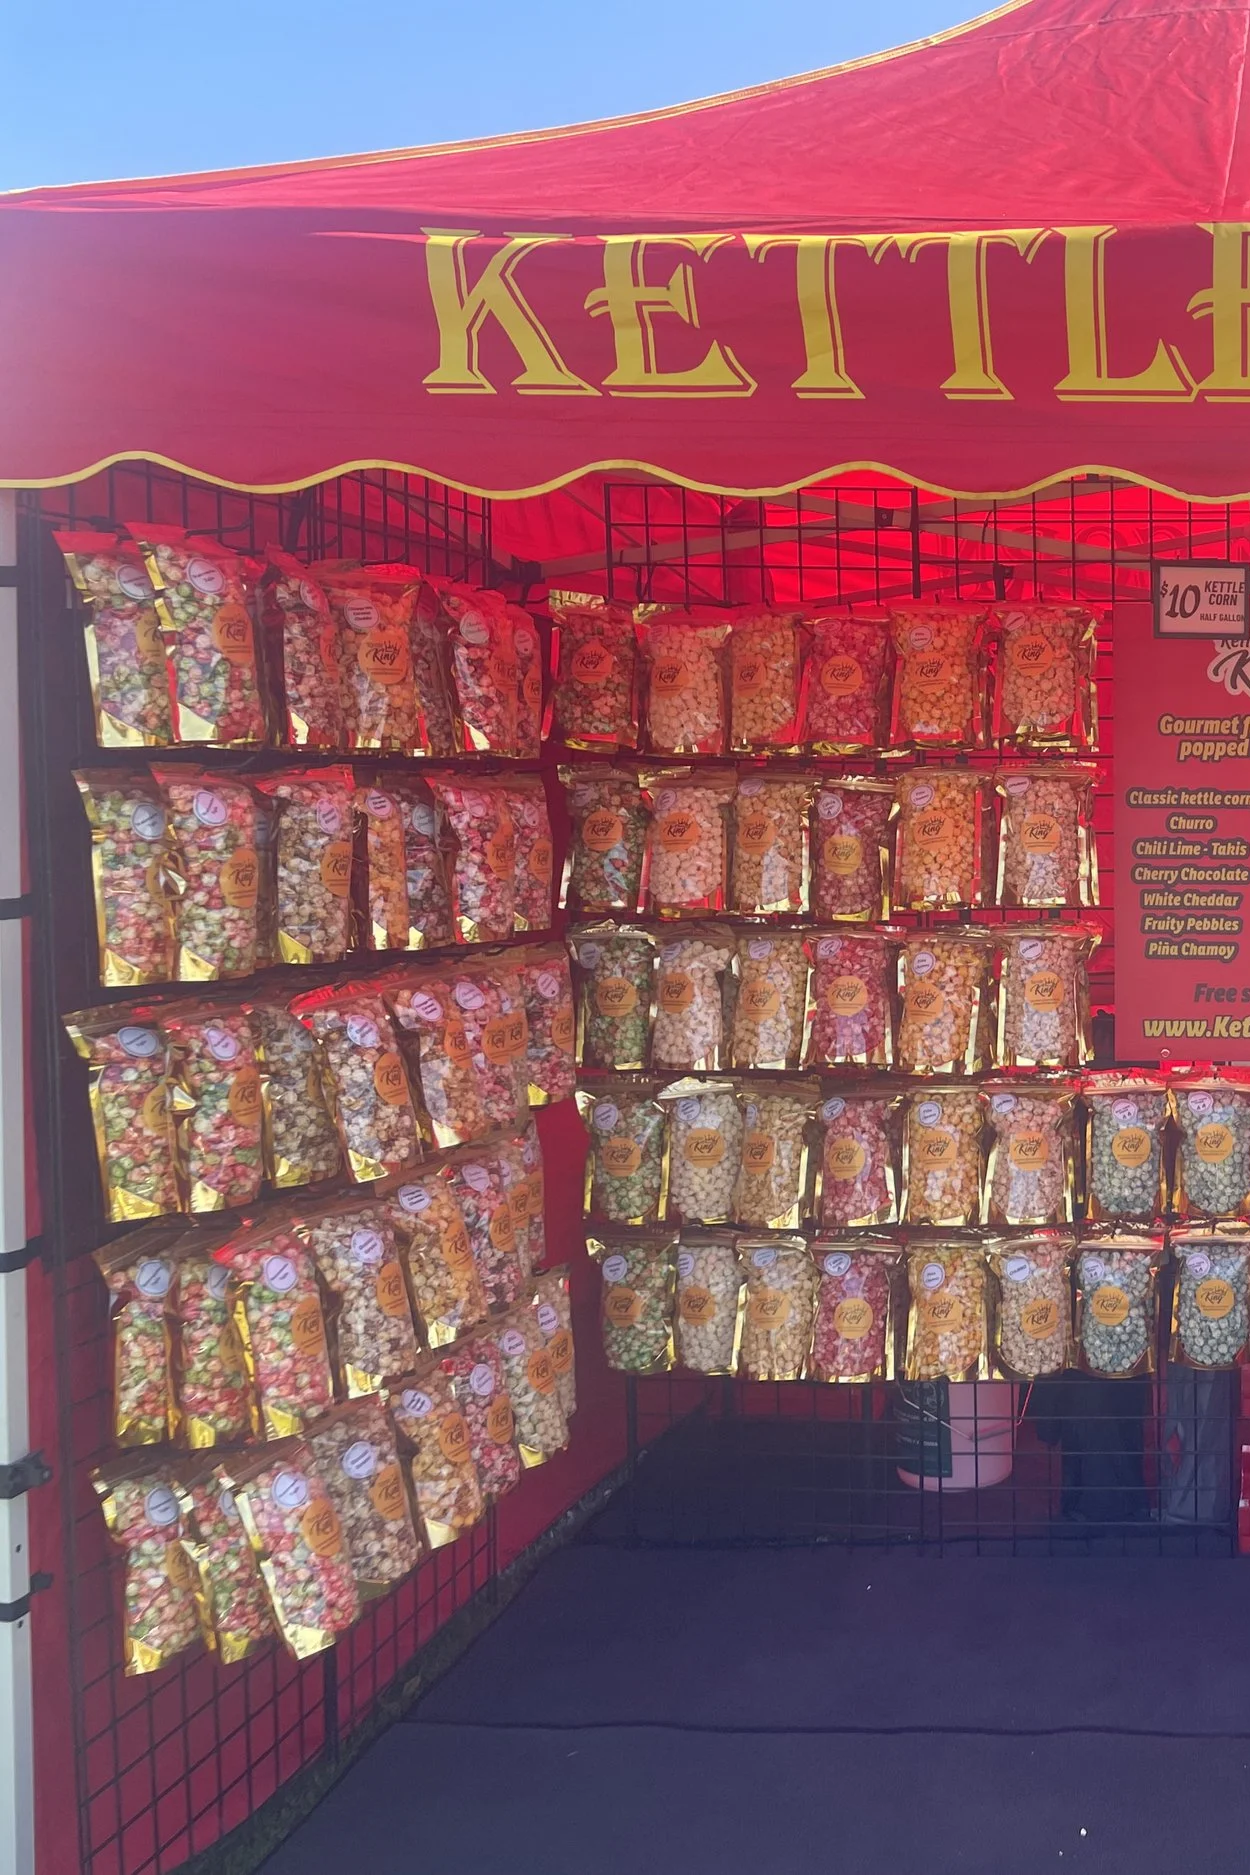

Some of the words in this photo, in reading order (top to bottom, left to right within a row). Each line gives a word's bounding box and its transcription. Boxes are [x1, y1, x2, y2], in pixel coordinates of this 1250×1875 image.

[1204, 581, 1245, 593] KETTLE
[1161, 580, 1201, 618] $10
[1209, 594, 1237, 606] CORN
[1200, 613, 1217, 621] HALF
[1160, 715, 1240, 735] Gourmet
[1179, 739, 1248, 761] popped
[1130, 791, 1178, 805] Classic
[1180, 791, 1222, 805] kettle
[1170, 816, 1213, 830] Churro
[1136, 841, 1167, 855] Chili
[1169, 842, 1201, 855] Lime
[1212, 842, 1247, 855] Takis
[1135, 867, 1178, 884] Cherry
[1181, 867, 1248, 881] Chocolate
[1144, 893, 1181, 906] White
[1183, 893, 1239, 907] Cheddar
[1144, 917, 1184, 934] Fruity
[1186, 918, 1239, 931] Pebbles
[1149, 942, 1178, 956] Piña
[1181, 943, 1235, 959] Chamoy
[1194, 983, 1237, 1003] Free
